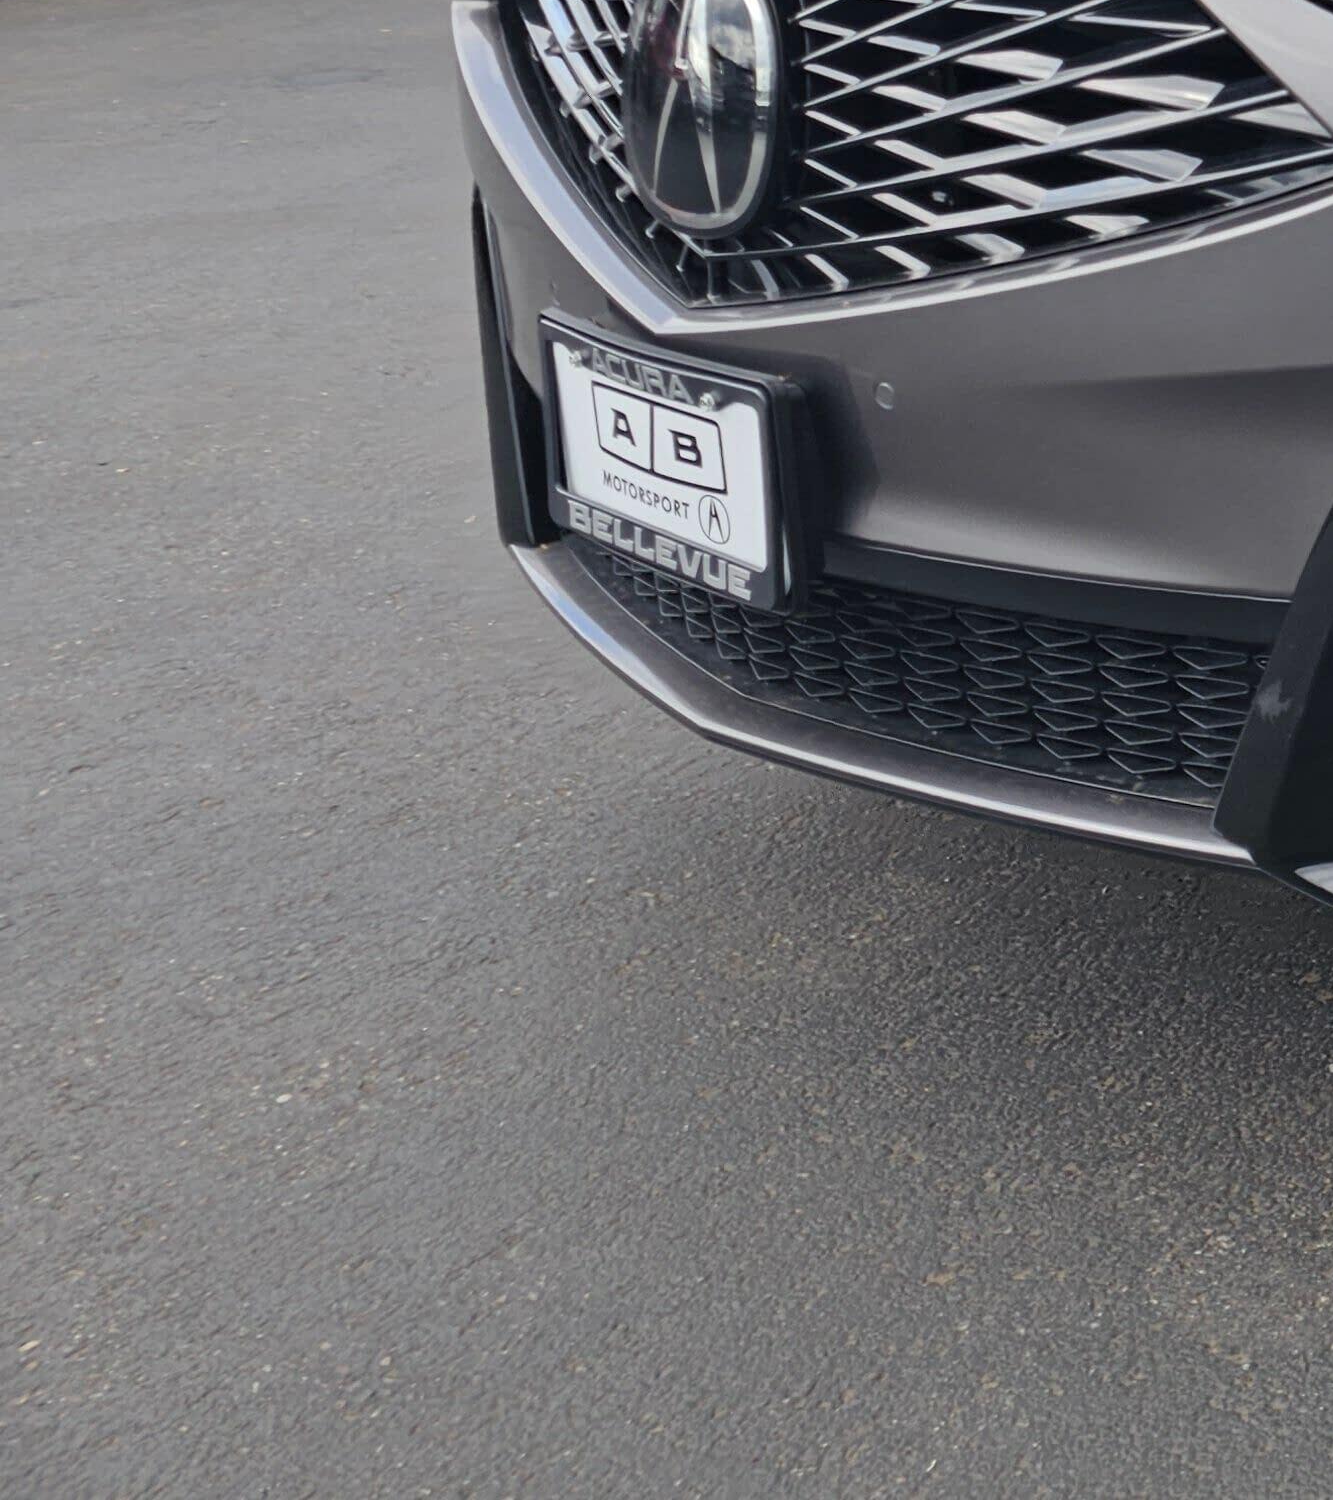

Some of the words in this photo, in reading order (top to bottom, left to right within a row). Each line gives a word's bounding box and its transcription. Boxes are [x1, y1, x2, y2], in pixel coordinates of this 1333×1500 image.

[590, 347, 694, 405] ACURA
[611, 407, 637, 447] A
[668, 428, 703, 468] B
[602, 470, 690, 520] MOTORSPORT
[567, 499, 752, 601] BELLEVUE
